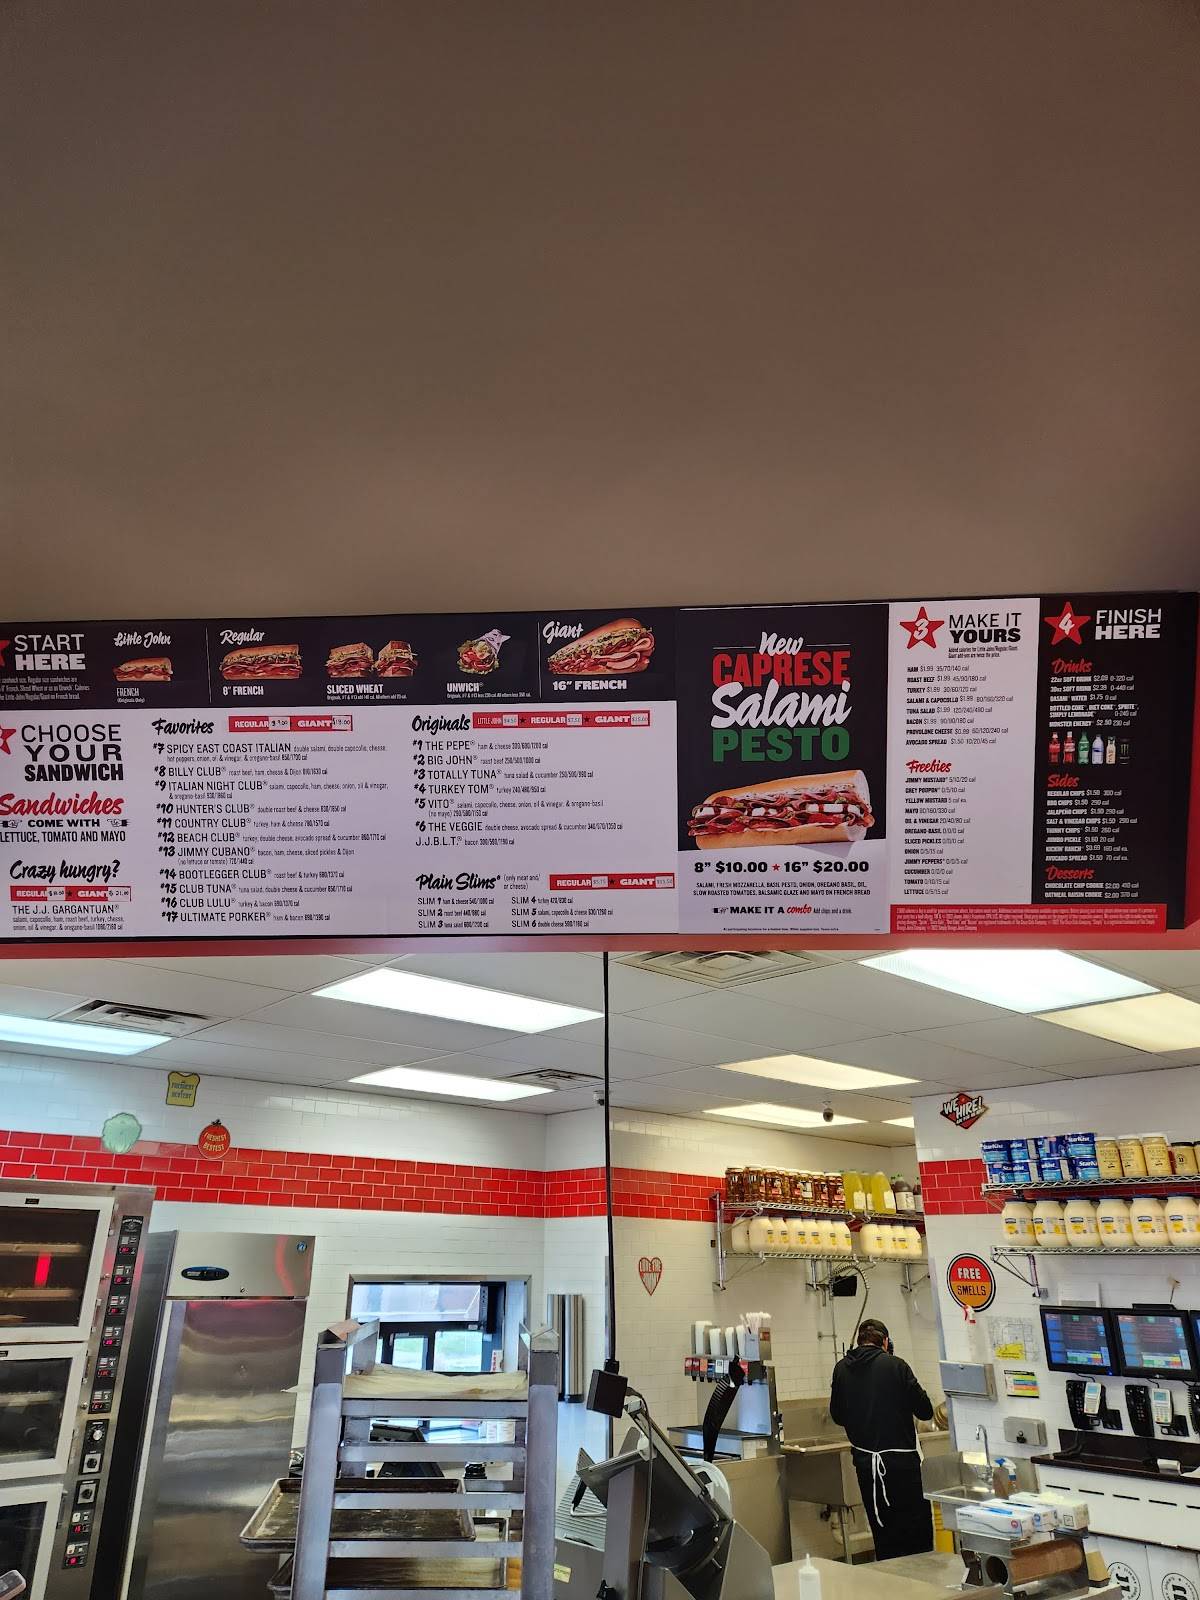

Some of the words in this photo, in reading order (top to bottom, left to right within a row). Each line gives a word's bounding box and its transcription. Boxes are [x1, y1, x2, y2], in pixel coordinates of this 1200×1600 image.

[949, 613, 1000, 628] MAKE
[1006, 613, 1022, 628] IT
[1096, 608, 1161, 624] FINISH
[913, 618, 929, 640] 3
[1058, 612, 1075, 635] 4
[220, 629, 265, 644] Regular
[543, 621, 583, 644] Giant
[950, 628, 1020, 644] YOURS
[1095, 624, 1160, 640] HERE
[14, 634, 85, 652] START
[114, 632, 141, 647] Little
[144, 632, 172, 648] John
[759, 632, 804, 656] New
[15, 654, 86, 670] HERE
[712, 650, 850, 687] CAPRESE
[1051, 658, 1093, 673] Drinks
[232, 686, 264, 696] FRENCH
[326, 684, 354, 694] SLICED
[356, 684, 384, 694] WHEAT
[574, 680, 627, 690] FRENCH
[117, 688, 139, 697] FRENCH
[710, 678, 852, 729] Salami
[152, 718, 214, 734] Favorites
[234, 720, 269, 728] REGULAR
[412, 714, 470, 735] Originals
[21, 724, 122, 742] CHOOSE
[153, 743, 165, 754] #7
[166, 744, 194, 754] SPICY
[197, 744, 219, 753] EAST
[222, 744, 253, 753] COAST
[256, 743, 291, 752] ITALIAN
[412, 740, 423, 750] #1
[425, 741, 443, 750] THE
[712, 726, 850, 762] PESTO
[24, 744, 122, 762] YOUR
[413, 754, 425, 765] #2
[427, 756, 442, 765] BIG
[24, 764, 124, 782] SANDWICH
[154, 766, 166, 777] #8
[168, 767, 193, 777] BILLY
[906, 759, 952, 774] Freebies
[414, 769, 426, 780] #3
[428, 770, 468, 779] TOTALLY
[1047, 774, 1080, 788] Sides
[155, 780, 166, 791] #9
[168, 781, 204, 790] ITALIAN
[206, 781, 235, 790] NIGHT
[414, 784, 426, 794] #4
[428, 785, 465, 794] TURKEY
[0, 792, 124, 816] Sandwiches
[156, 803, 173, 814] #10
[176, 804, 222, 813] HUNTER'S
[415, 799, 426, 809] #5
[28, 820, 63, 828] COME
[67, 820, 100, 828] WITH
[157, 818, 172, 828] #11
[174, 819, 219, 828] COUNTRY
[416, 821, 426, 832] #6
[428, 822, 446, 831] THE
[449, 822, 482, 831] VEGGIE
[42, 831, 78, 842] TOMATO
[81, 831, 98, 842] AND
[101, 831, 125, 841] MAYO
[158, 832, 175, 843] #12
[177, 833, 208, 842] BEACH
[158, 846, 176, 857] #13
[178, 847, 208, 857] JIMMY
[10, 860, 56, 883] Crazy
[60, 860, 120, 883] hungry?
[715, 861, 768, 874] $10.00
[813, 860, 869, 873] $20.00
[1046, 865, 1095, 880] Desserts
[160, 869, 176, 880] #14
[179, 870, 239, 879] BOOTLEGGER
[416, 872, 453, 890] Plain
[504, 874, 515, 882] (only
[160, 884, 177, 894] #15
[179, 884, 204, 893] CLUB
[161, 898, 177, 908] #16
[180, 898, 204, 907] CLUB
[730, 906, 762, 914] MAKE
[764, 906, 775, 914] IT
[786, 904, 812, 914] combo
[13, 906, 30, 914] THE
[33, 906, 50, 914] J.J.
[162, 912, 178, 922] #17
[180, 912, 226, 921] ULTIMATE
[944, 1098, 960, 1114] WE
[956, 1096, 982, 1119] HIRE!
[957, 1268, 981, 1280] FREE
[957, 1285, 986, 1296] SMELLS
